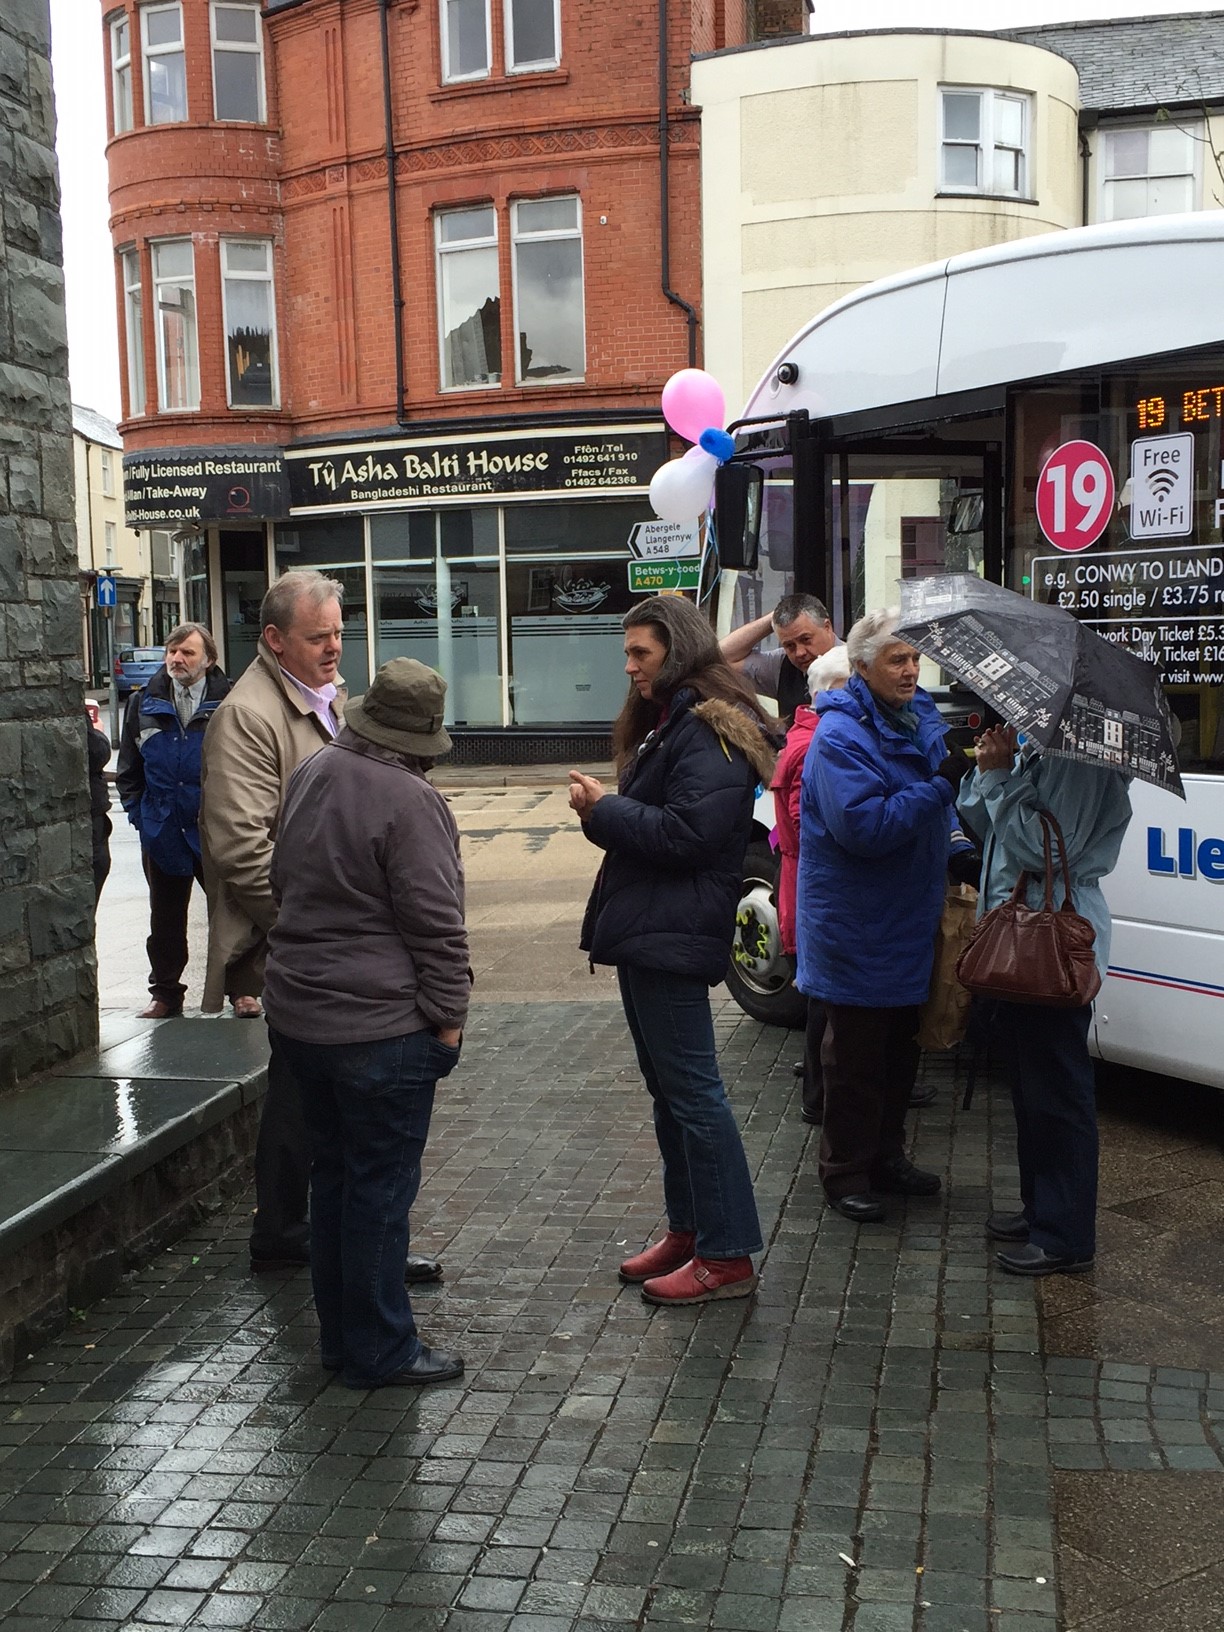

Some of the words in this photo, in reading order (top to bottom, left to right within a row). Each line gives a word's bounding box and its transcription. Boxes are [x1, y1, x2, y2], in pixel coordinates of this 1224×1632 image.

[1137, 397, 1165, 428] 19
[1183, 386, 1224, 421] BET
[606, 443, 624, 453] Tel
[1143, 448, 1181, 467] Free
[340, 455, 399, 484] Asha
[403, 451, 460, 480] Balti
[466, 450, 550, 475] House
[563, 454, 596, 464] 01492
[597, 453, 616, 462] 641
[618, 452, 638, 461] 910
[131, 464, 150, 482] Fully
[151, 462, 203, 478] Licensed
[205, 459, 282, 475] Restaurant
[571, 468, 601, 478] Ffacs
[608, 467, 629, 476] Fax
[351, 484, 420, 501] Bangladeshi
[423, 480, 493, 495] Restaurant
[565, 477, 597, 487] 01492
[146, 485, 207, 500] Take-Away
[1046, 460, 1108, 534] 19
[1139, 505, 1184, 528] Wi-Fi
[645, 523, 681, 534] Abergele
[645, 533, 692, 545] Llangernyw
[635, 563, 701, 576] Betws-y-coed
[1044, 572, 1070, 589] e.g.
[1074, 563, 1138, 584] CONWY
[1140, 561, 1164, 580] TO
[1169, 557, 1224, 579] LLAND
[1058, 589, 1100, 609] £2.50
[1103, 587, 1147, 611] single
[1149, 586, 1159, 607] /
[1162, 585, 1209, 605] £3.75
[1132, 626, 1157, 646] Day
[1158, 625, 1194, 641] Ticket
[1163, 645, 1200, 661] Ticket
[1168, 669, 1190, 683] visit
[1147, 826, 1224, 884] Lle
